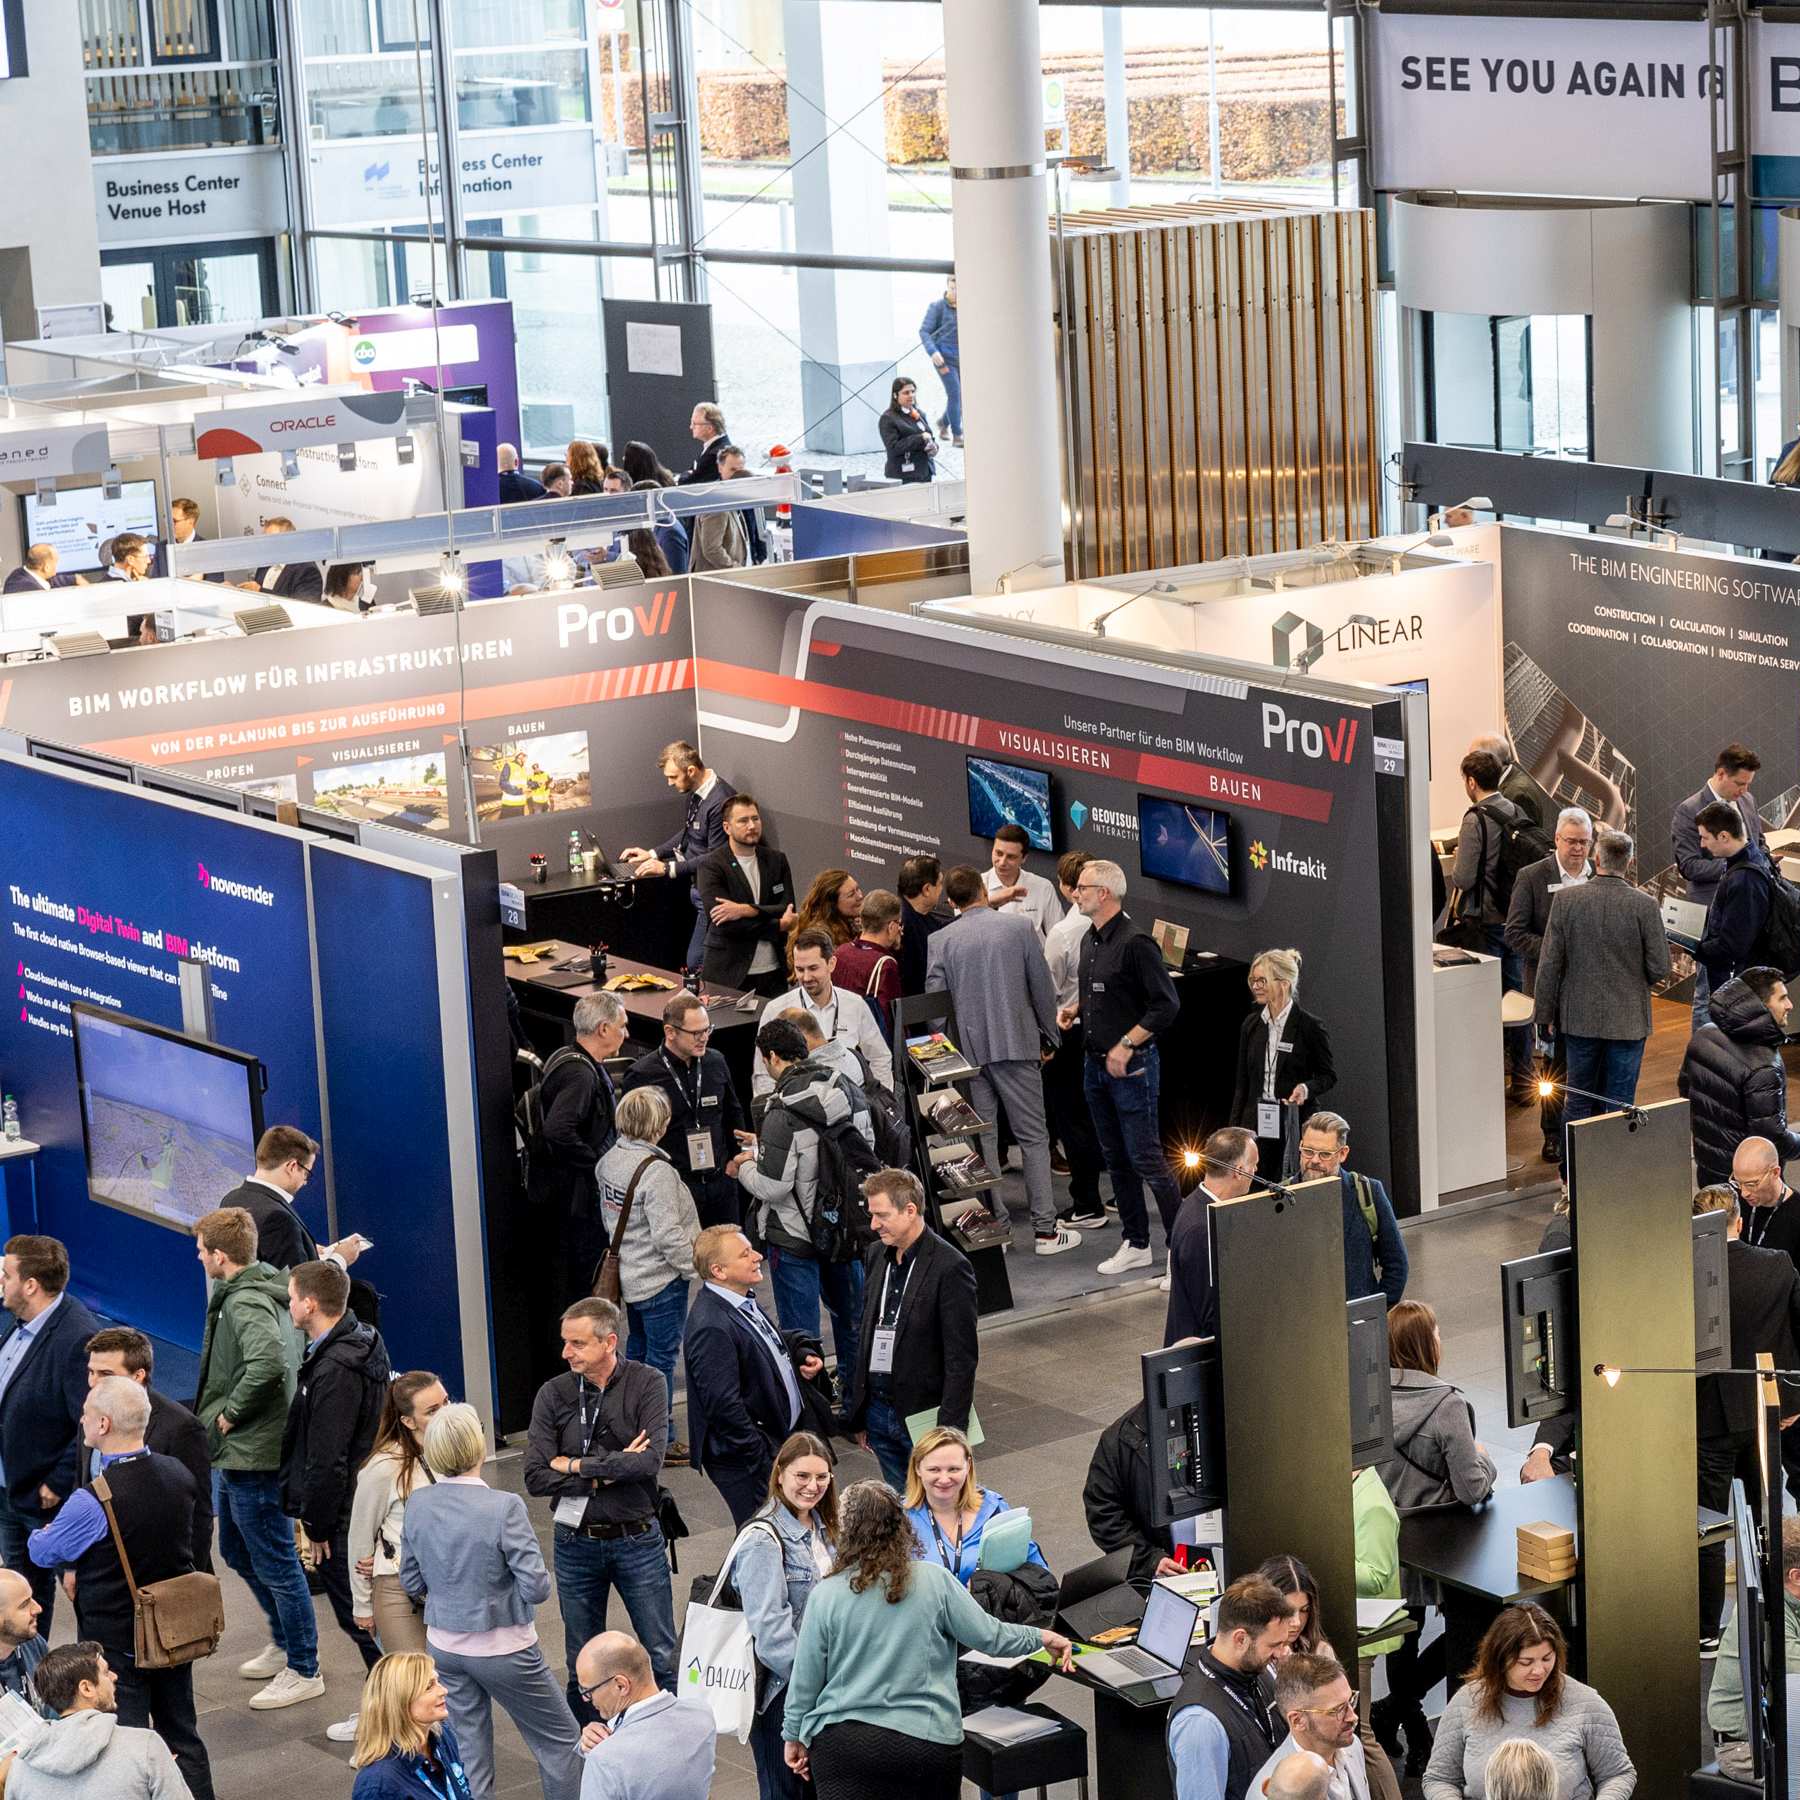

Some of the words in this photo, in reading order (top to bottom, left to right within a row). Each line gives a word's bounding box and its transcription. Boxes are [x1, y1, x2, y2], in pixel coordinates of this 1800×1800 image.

[1400, 55, 1471, 92] SEE
[1481, 57, 1556, 95] YOU
[1567, 60, 1686, 99] AGAIN
[418, 159, 486, 174] Buess
[492, 153, 543, 169] Center
[106, 177, 180, 198] Business
[185, 175, 240, 193] Center
[108, 201, 162, 220] Venue
[168, 199, 206, 217] Host
[270, 415, 336, 433] ORACLE
[256, 474, 288, 491] Connect
[1570, 553, 1597, 575] THE
[1601, 558, 1627, 580] BIM
[1631, 562, 1729, 597] ENGINEERING
[1337, 615, 1423, 652] LINEAR
[1594, 605, 1656, 626] CONSTRUCTION
[1670, 618, 1725, 638] CALCULATION
[1738, 629, 1789, 648] SIMULATION
[1567, 622, 1629, 643] COORDINATION
[1641, 635, 1708, 657] COLLABORATION
[1719, 648, 1757, 666] INDUSTRY
[1759, 653, 1779, 670] DATA
[69, 693, 110, 717] BIM
[118, 674, 248, 710] WORKFLOW
[255, 666, 298, 690] FÜR
[306, 638, 513, 685] INFRASTRUKTUREN
[151, 740, 180, 756] VON
[186, 736, 214, 751] DER
[220, 726, 287, 748] PLANUNG
[292, 721, 315, 736] BIS
[320, 716, 347, 732] ZUR
[352, 702, 446, 728] AUSFÜHRUNG
[508, 721, 545, 737] BAUEN
[844, 732, 858, 744] Hohe
[1064, 714, 1097, 734] Unsere
[1100, 723, 1136, 742] Partner
[1139, 730, 1152, 746] für
[1155, 735, 1173, 750] den
[1176, 738, 1194, 754] BIM
[1197, 742, 1244, 764] Workflow
[332, 740, 420, 762] VISUALISIEREN
[999, 730, 1111, 769] VISUALISIEREN
[206, 764, 254, 782] PRÜFEN
[1384, 759, 1396, 772] 29
[1209, 776, 1261, 801] BAUEN
[878, 824, 887, 832] der
[1092, 806, 1138, 830] GEOVISUA
[1093, 823, 1139, 841] INTERACTIV
[1270, 849, 1327, 880] Infrakit
[211, 875, 274, 907] novorender
[508, 909, 518, 924] 28
[10, 885, 30, 908] The
[32, 893, 75, 922] ultimate
[77, 906, 113, 935] Digital
[115, 918, 141, 942] Twin
[142, 930, 163, 949] and
[165, 933, 189, 957] BIM
[190, 942, 240, 973] platform
[12, 922, 26, 937] The
[26, 925, 39, 942] first
[39, 930, 57, 948] cloud
[58, 935, 78, 954] native
[78, 943, 126, 970] Browser-based
[127, 960, 149, 976] viewer
[150, 965, 164, 981] that
[164, 972, 177, 985] can
[24, 967, 58, 987] Cloud-based
[58, 980, 70, 991] with
[70, 984, 82, 996] tons
[83, 987, 89, 997] of
[89, 989, 121, 1008] integrations
[26, 990, 43, 1005] Works
[44, 998, 51, 1007] on
[28, 1013, 49, 1030] Handles
[50, 1022, 59, 1035] any
[60, 1023, 69, 1036] file
[706, 1666, 750, 1692] DALUX
